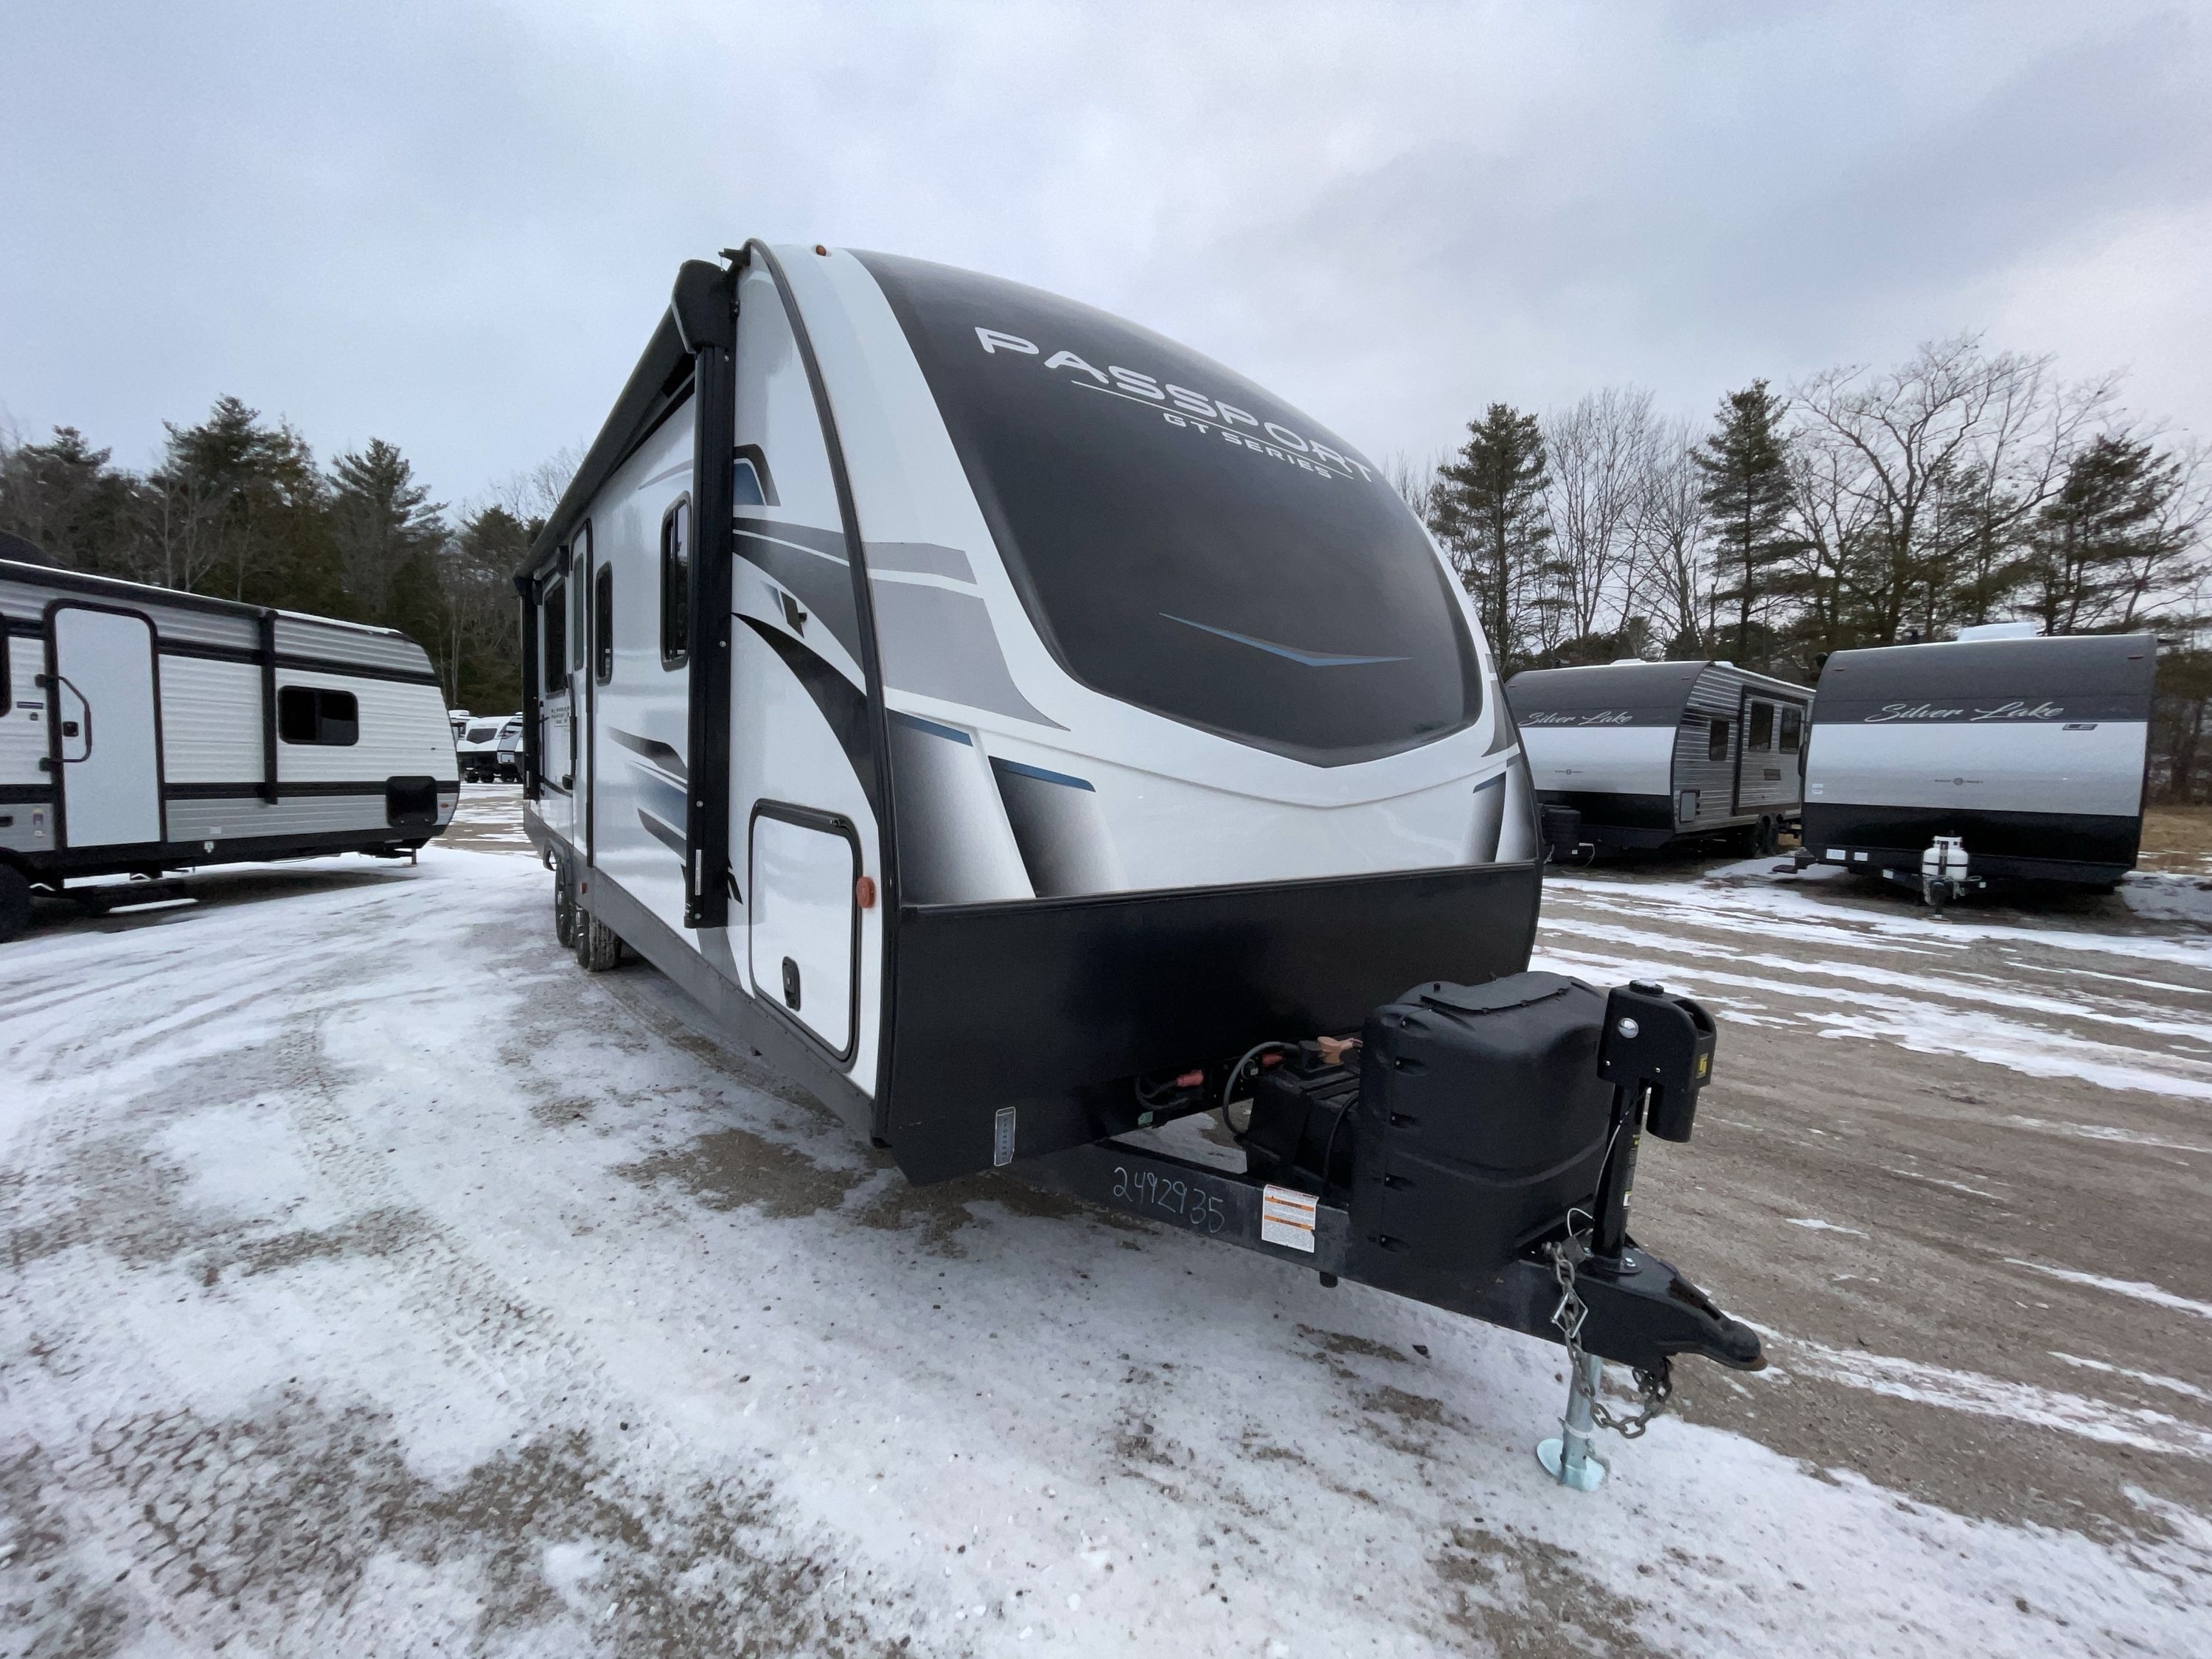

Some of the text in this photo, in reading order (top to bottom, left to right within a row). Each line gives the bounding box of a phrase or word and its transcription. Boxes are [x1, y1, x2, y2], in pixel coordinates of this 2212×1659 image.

[975, 327, 1374, 482] PASSPORT
[1163, 413, 1332, 479] GT SERIES
[1517, 711, 1633, 726] Silver Lake
[1865, 701, 2064, 722] Silver Lake
[1113, 1166, 1225, 1234] 2492935
